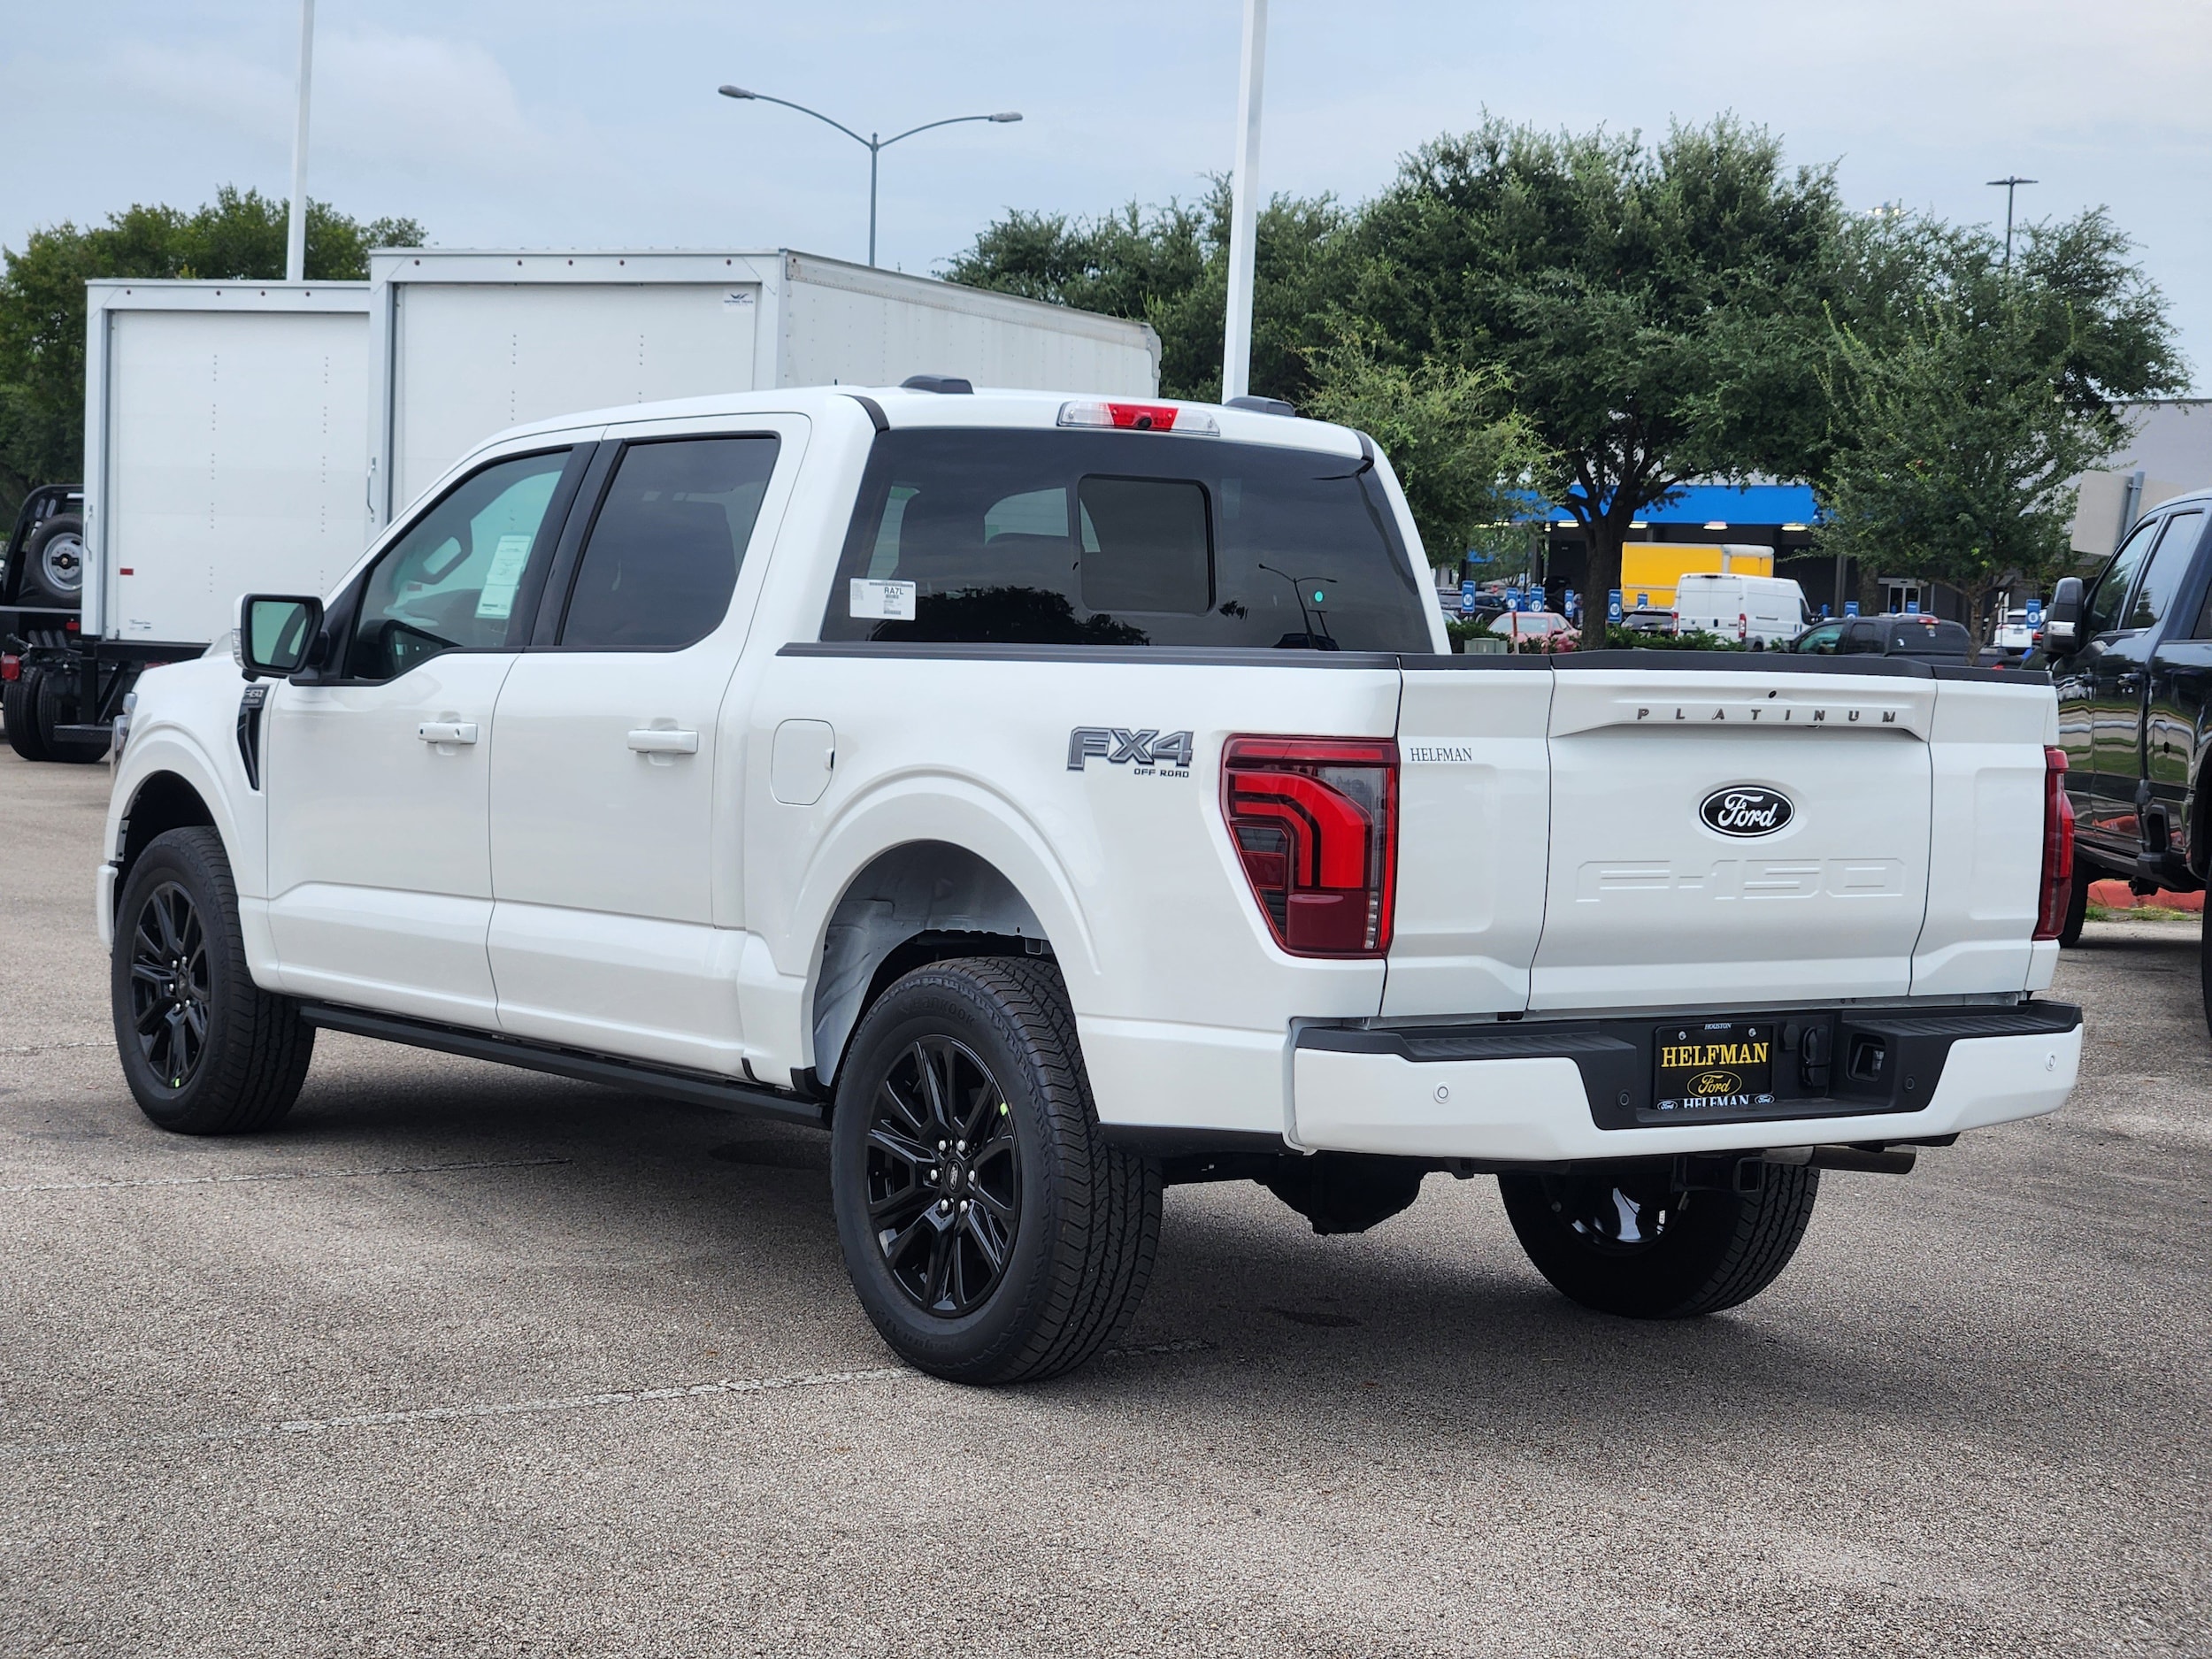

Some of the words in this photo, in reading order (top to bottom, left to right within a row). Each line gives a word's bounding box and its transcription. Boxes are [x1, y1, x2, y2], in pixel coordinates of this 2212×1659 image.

[1637, 707, 1896, 723] PLATINUM
[1067, 726, 1194, 772] FX4
[1409, 748, 1472, 762] HELFMAN
[1133, 767, 1156, 776] OFF
[1159, 769, 1190, 779] ROAD
[1717, 793, 1778, 827] Ford
[1575, 857, 1907, 902] F-150
[1704, 1022, 1732, 1031] HOUSTON
[1661, 1042, 1769, 1067] HELFMAN
[1697, 1073, 1732, 1094] Ford
